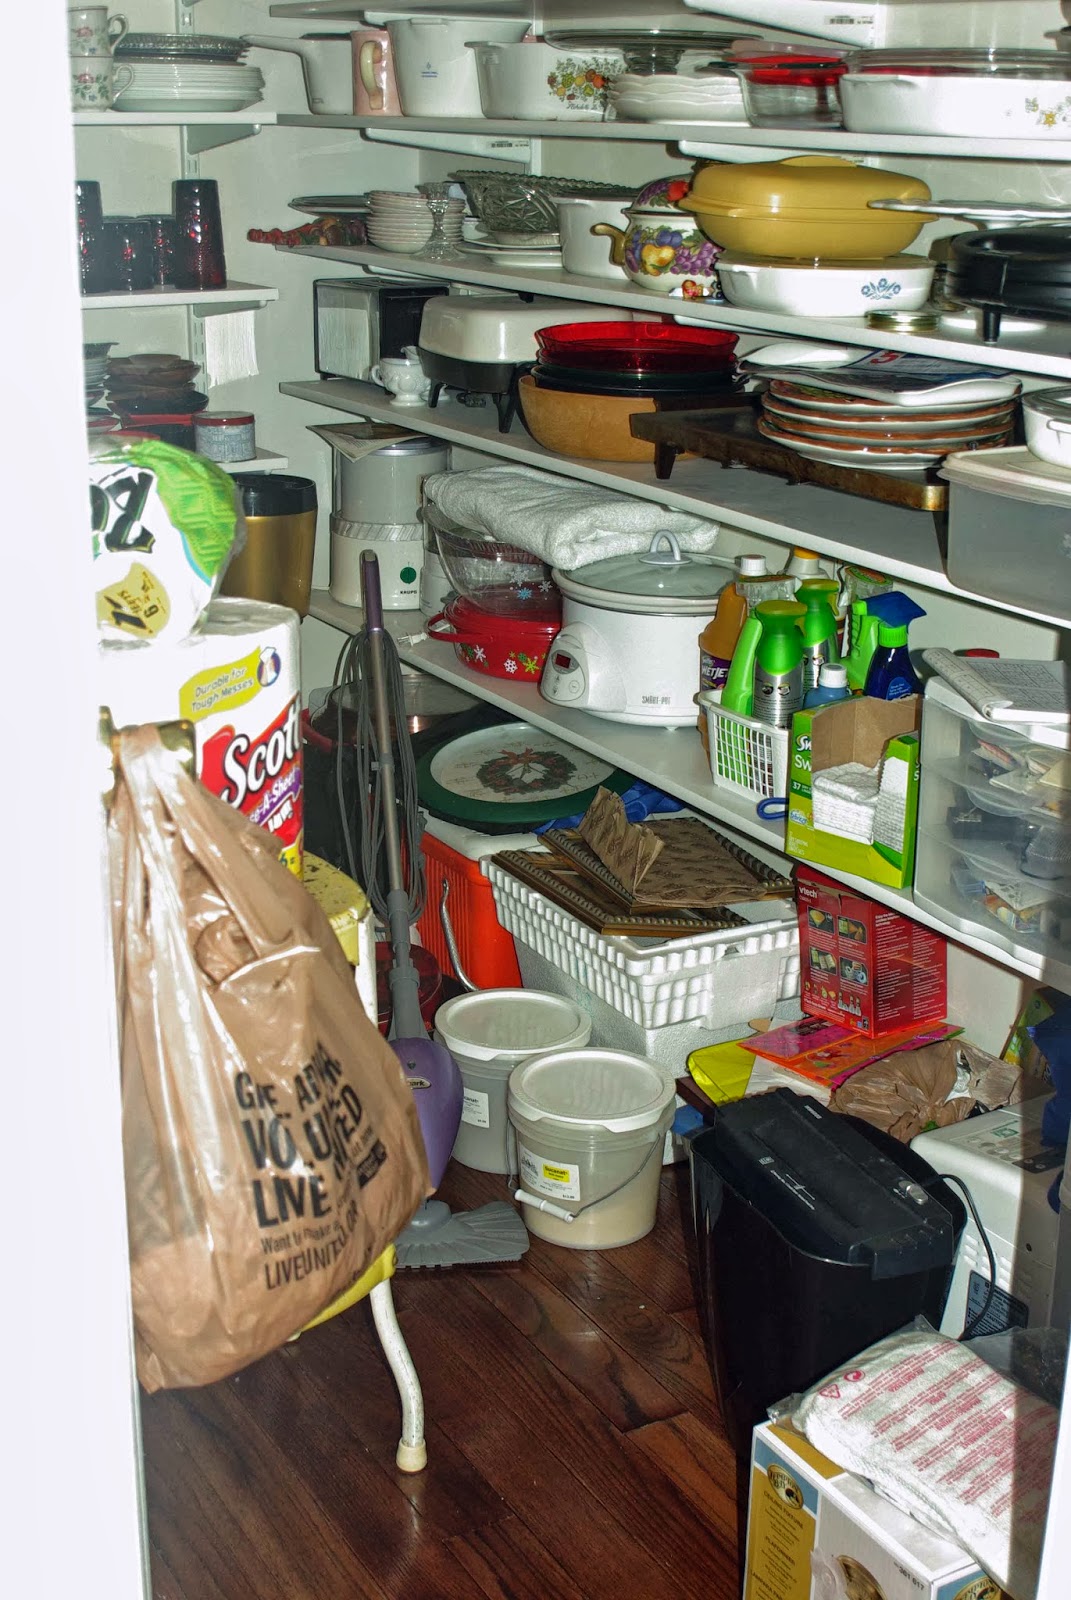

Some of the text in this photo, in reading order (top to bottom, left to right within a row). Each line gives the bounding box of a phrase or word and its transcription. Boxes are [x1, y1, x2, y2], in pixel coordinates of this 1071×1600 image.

[191, 678, 254, 712] Tough Messes
[195, 666, 247, 698] Durable for
[220, 691, 300, 809] Scott
[792, 781, 801, 791] 37
[799, 886, 818, 899] vtech
[252, 1174, 332, 1229] LIVE
[261, 1233, 291, 1255] Want
